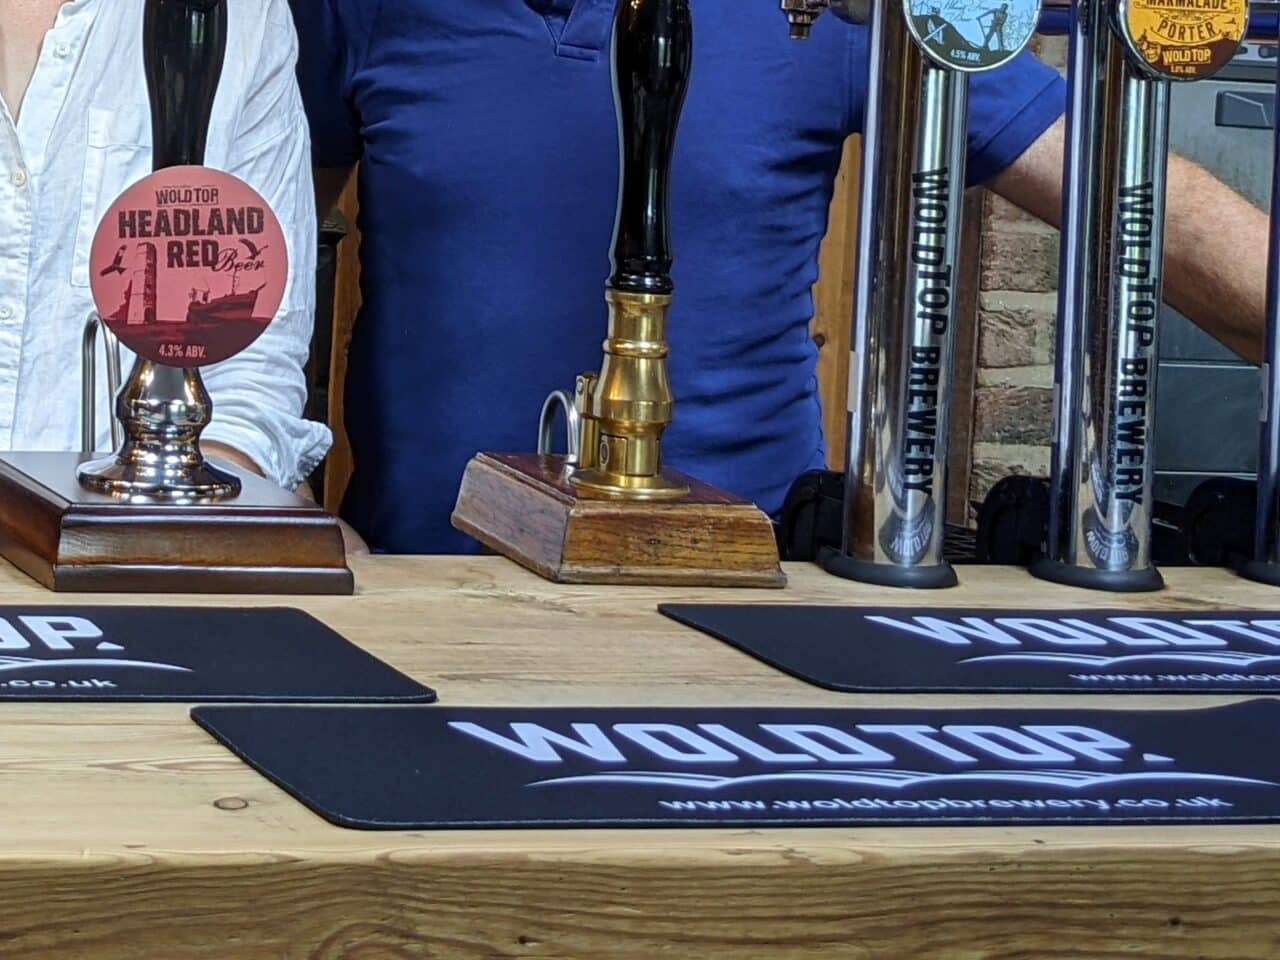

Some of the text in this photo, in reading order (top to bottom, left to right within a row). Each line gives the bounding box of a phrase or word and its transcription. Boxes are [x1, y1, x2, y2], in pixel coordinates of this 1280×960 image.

[1157, 18, 1217, 41] PORTER
[1162, 48, 1211, 66] WOLD TOP
[156, 187, 219, 205] WOLD TOP
[118, 207, 264, 239] HEADLAND
[167, 239, 264, 272] RED Beer
[904, 167, 952, 497] WOLD TOP BREWERY
[1115, 181, 1157, 505] WOLD TOP BREWERY
[158, 344, 183, 358] 4.3%
[864, 615, 1227, 645] WOLD
[447, 721, 895, 763] WOLD
[658, 796, 1233, 810] www.woldtopbrewery.co.uk
